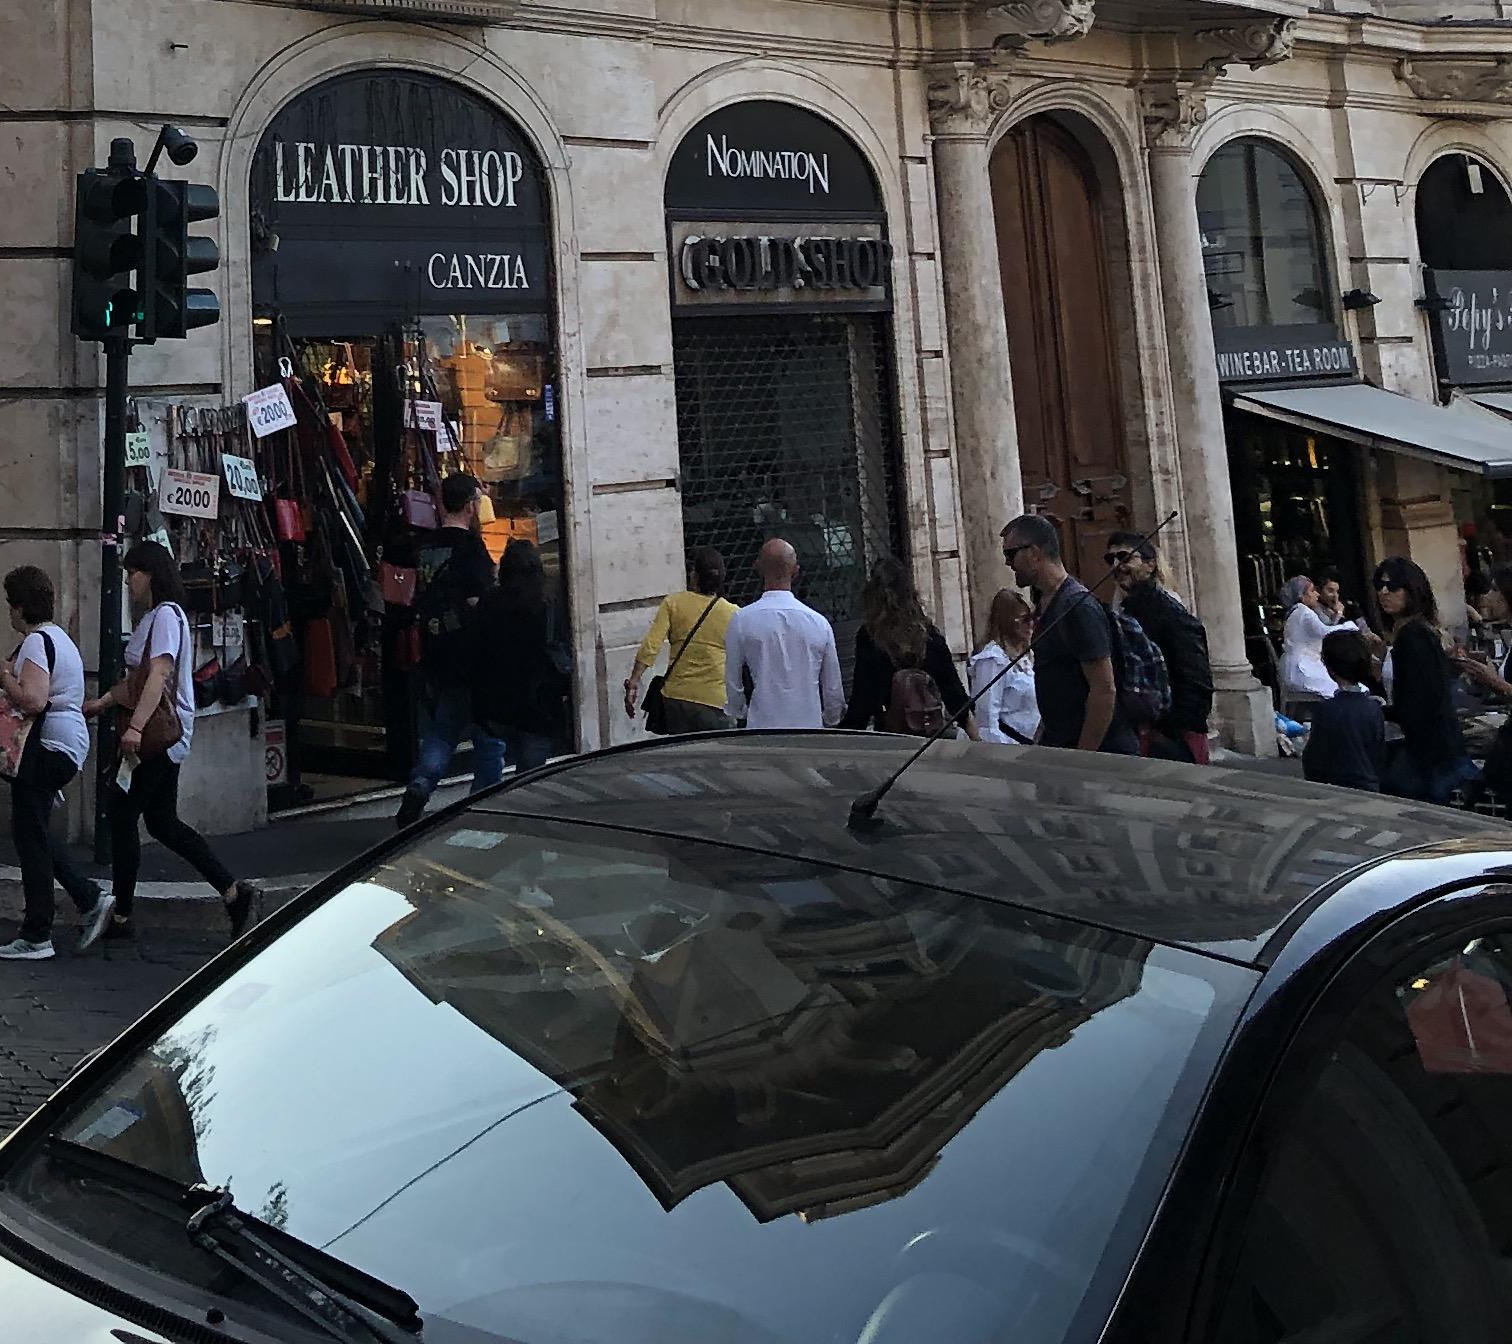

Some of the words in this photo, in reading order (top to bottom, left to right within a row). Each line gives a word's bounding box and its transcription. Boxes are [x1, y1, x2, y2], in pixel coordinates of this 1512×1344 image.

[273, 141, 431, 205] LEATHER
[440, 148, 523, 207] SHOP
[427, 252, 530, 289] CANZIA
[1313, 346, 1351, 371] ROOM
